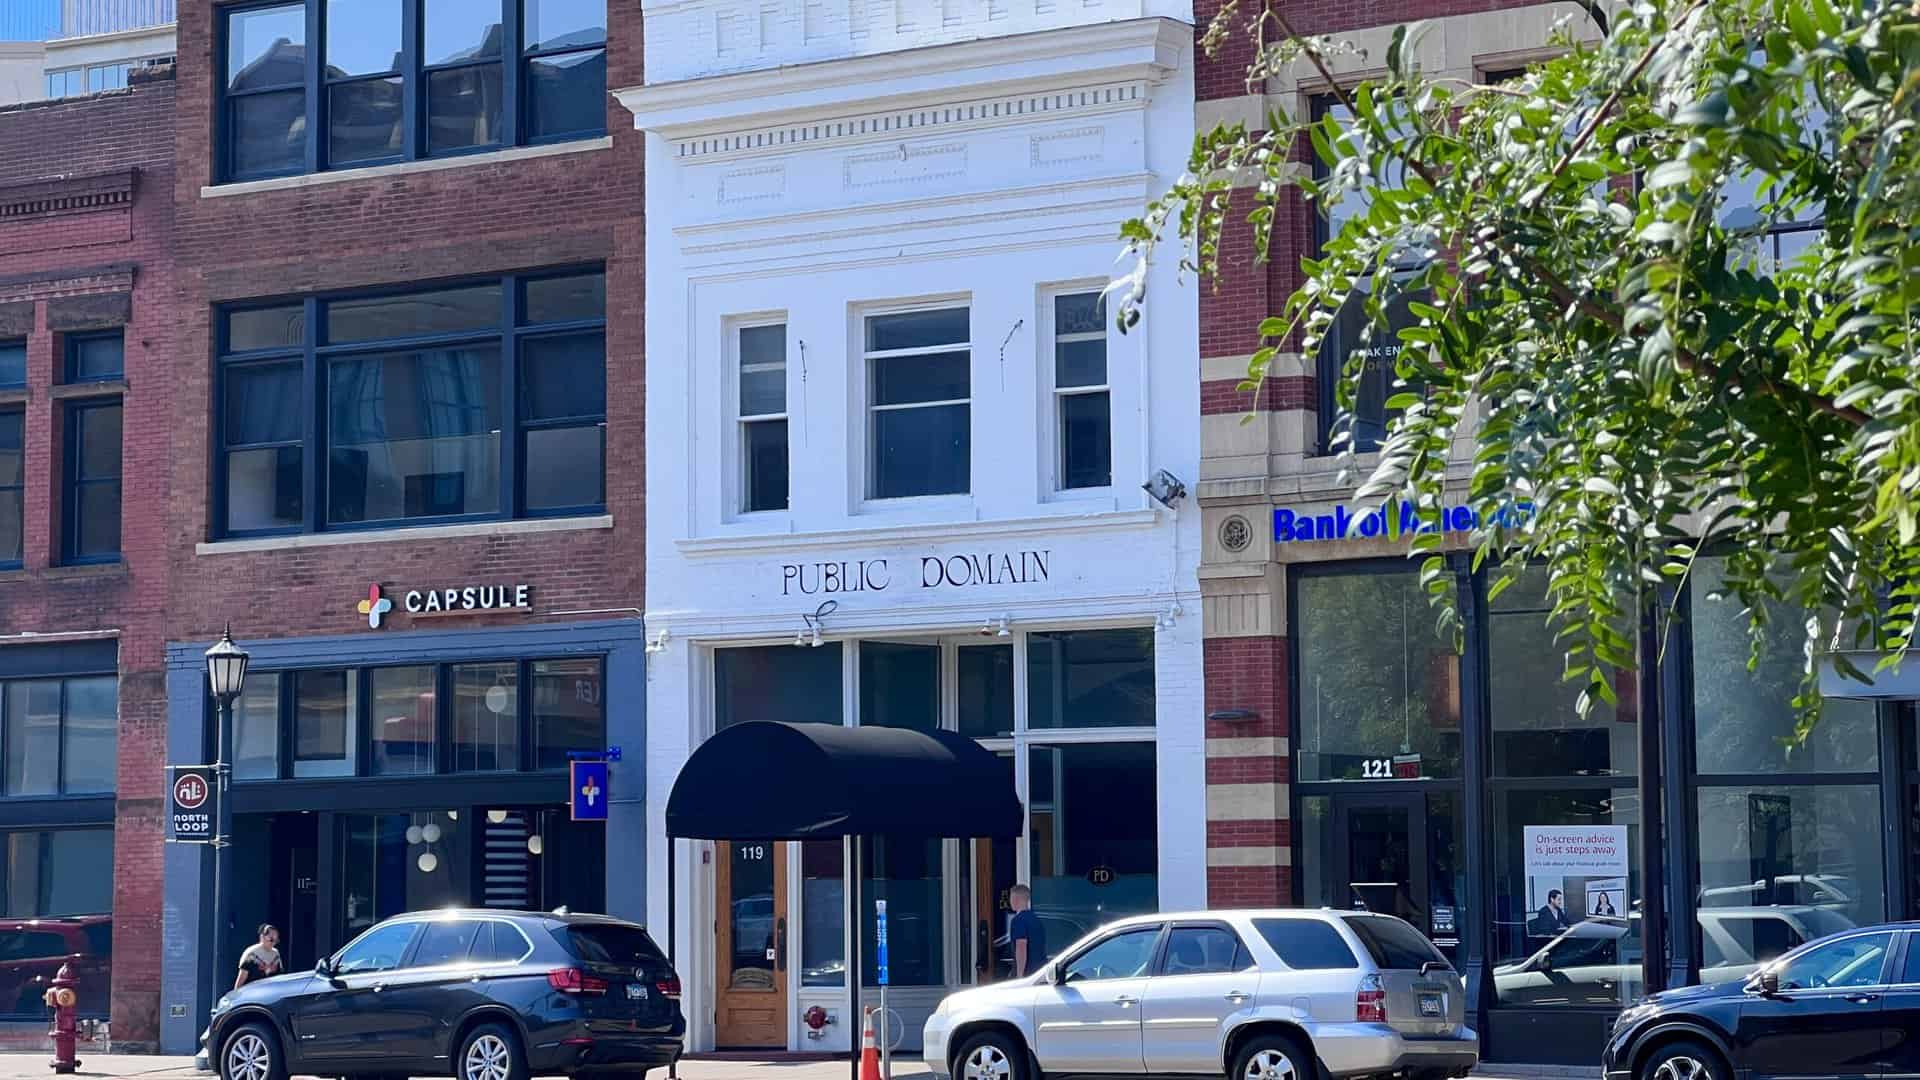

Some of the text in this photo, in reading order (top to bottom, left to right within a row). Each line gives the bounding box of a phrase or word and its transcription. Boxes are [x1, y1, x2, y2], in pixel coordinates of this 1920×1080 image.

[1273, 504, 1354, 542] Bank
[781, 550, 1051, 595] PUBLIC DOMAIN
[405, 584, 529, 612] CAPSULE
[1361, 759, 1393, 778] 121
[175, 822, 209, 832] LOOP
[1536, 832, 1616, 844] On-screen advice
[740, 846, 764, 860] 119
[1535, 844, 1617, 856] is just steps away
[1093, 870, 1109, 882] PD
